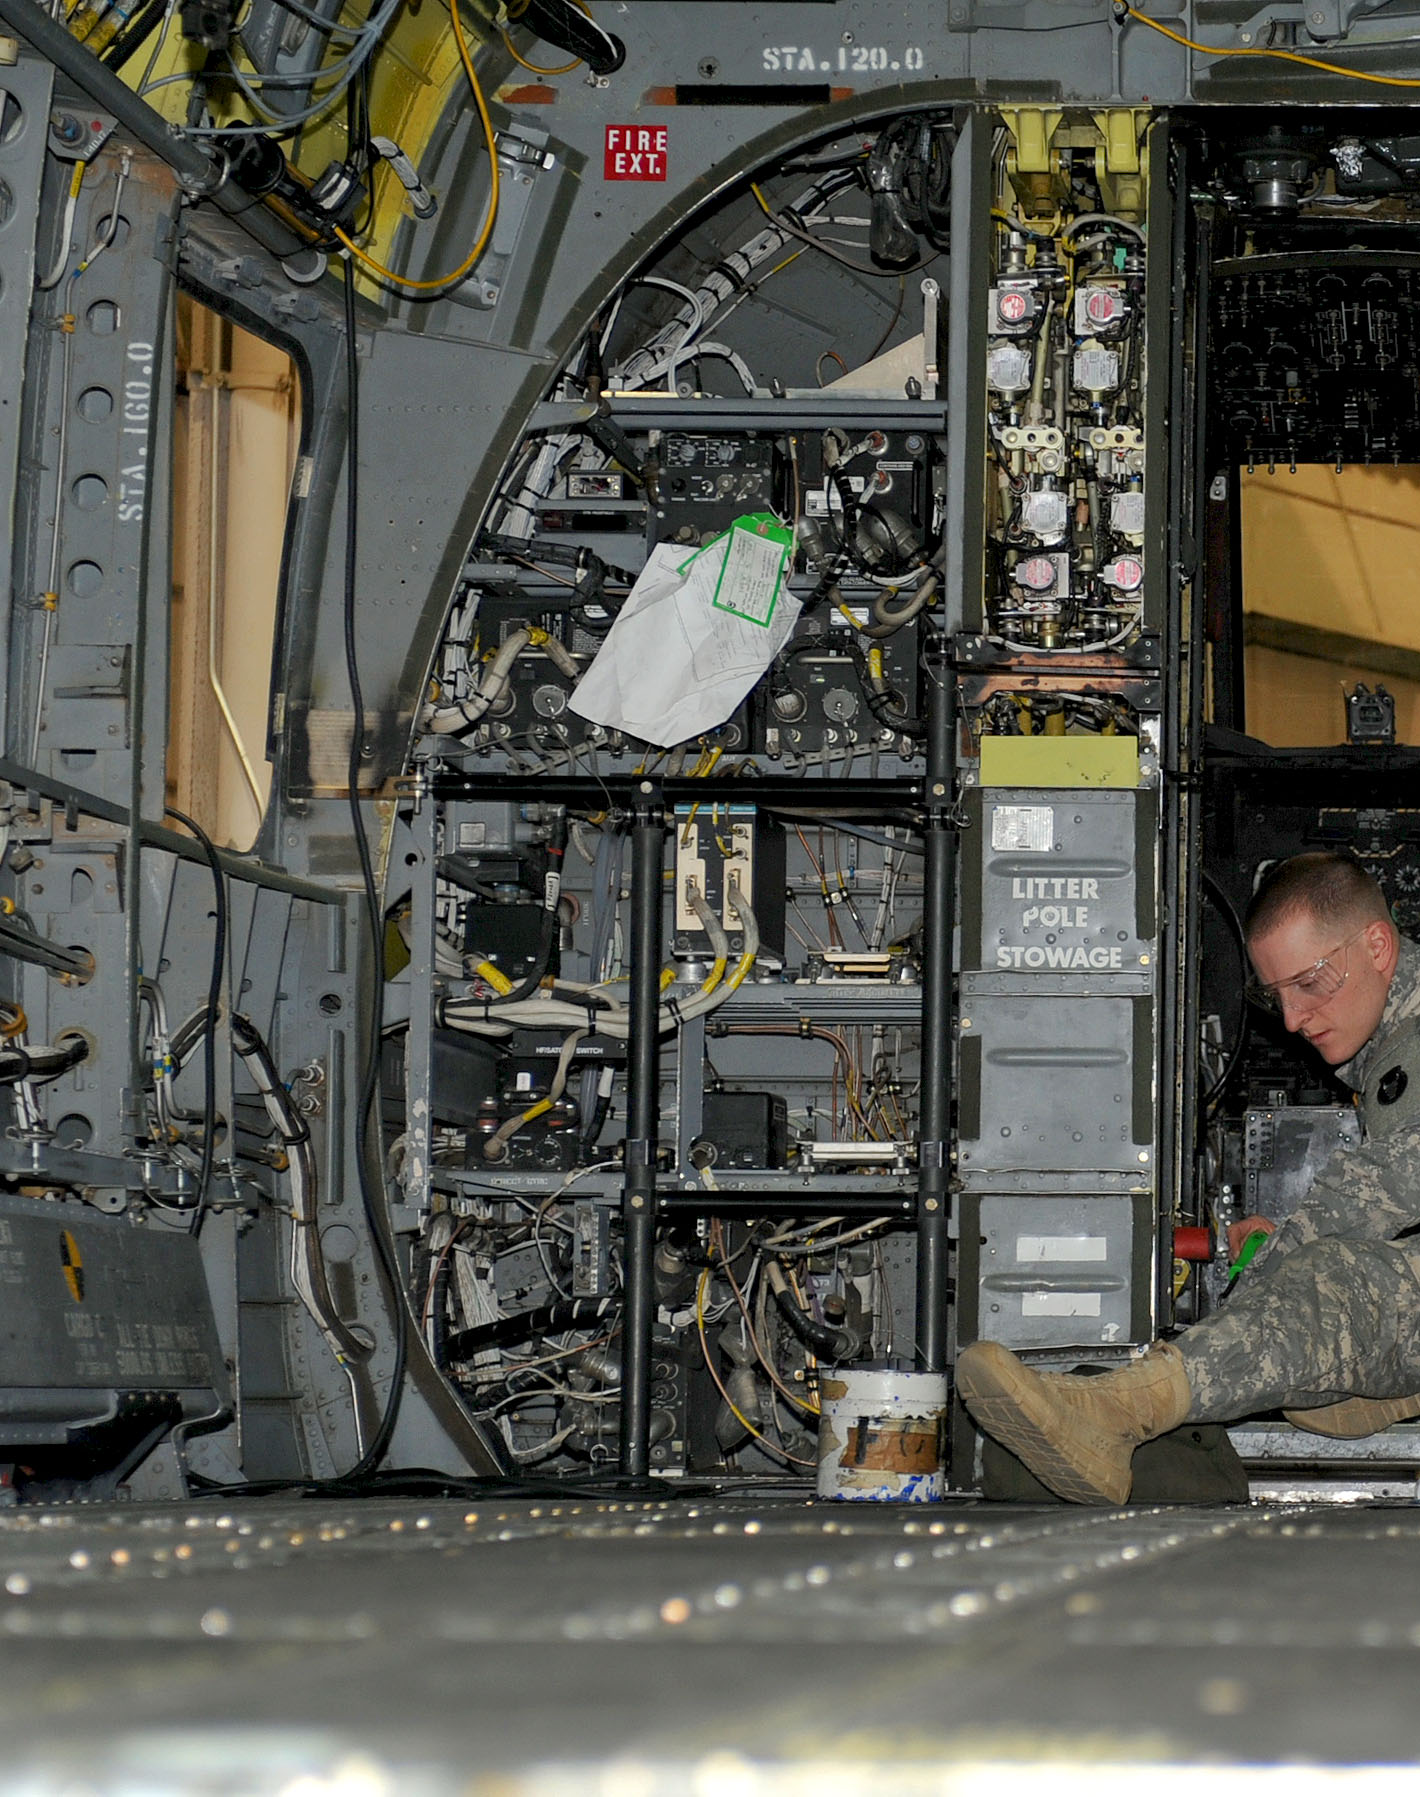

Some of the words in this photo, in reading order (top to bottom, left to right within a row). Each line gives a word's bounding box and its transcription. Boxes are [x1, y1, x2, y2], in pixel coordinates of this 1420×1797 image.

[763, 47, 924, 71] STA.120.0
[608, 129, 667, 151] FIRE
[615, 152, 661, 174] EXT.
[1012, 877, 1100, 899] LITTER
[1023, 905, 1089, 927] POLE
[996, 946, 1123, 969] STOWAGE
